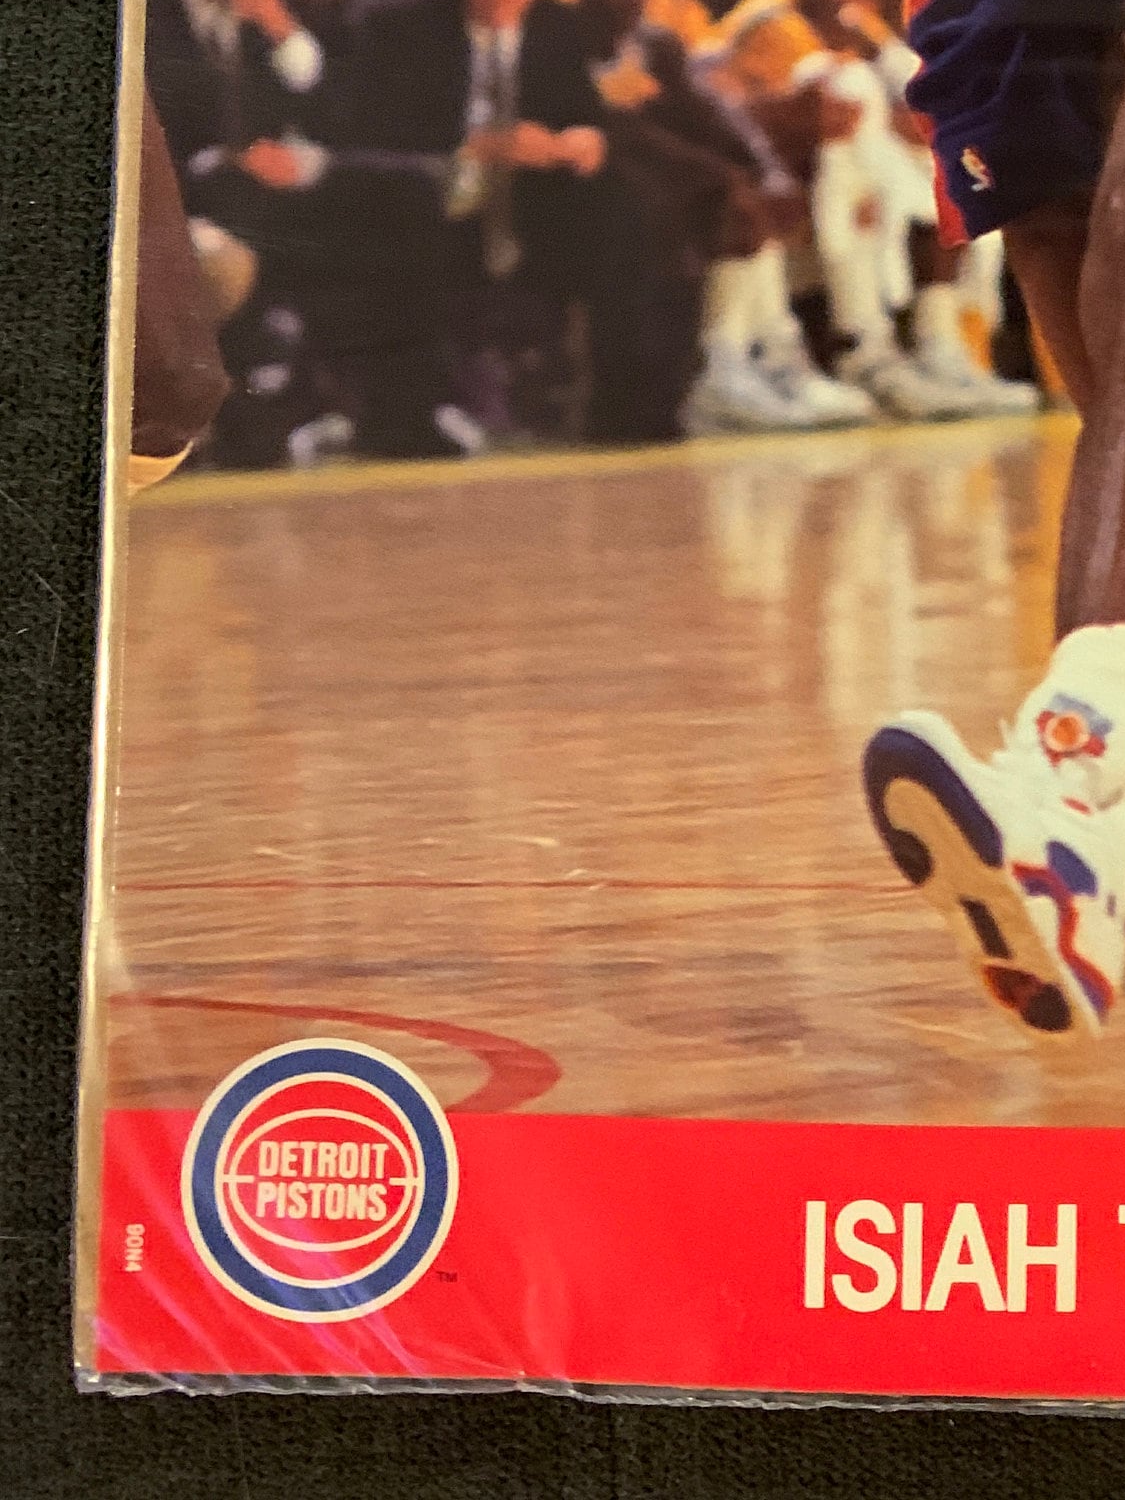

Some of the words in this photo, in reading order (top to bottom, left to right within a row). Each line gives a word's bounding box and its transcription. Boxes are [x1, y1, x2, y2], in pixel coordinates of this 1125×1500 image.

[258, 1140, 390, 1179] DETROIT
[254, 1183, 388, 1222] PISTONS
[803, 1198, 1078, 1314] ISIAH
